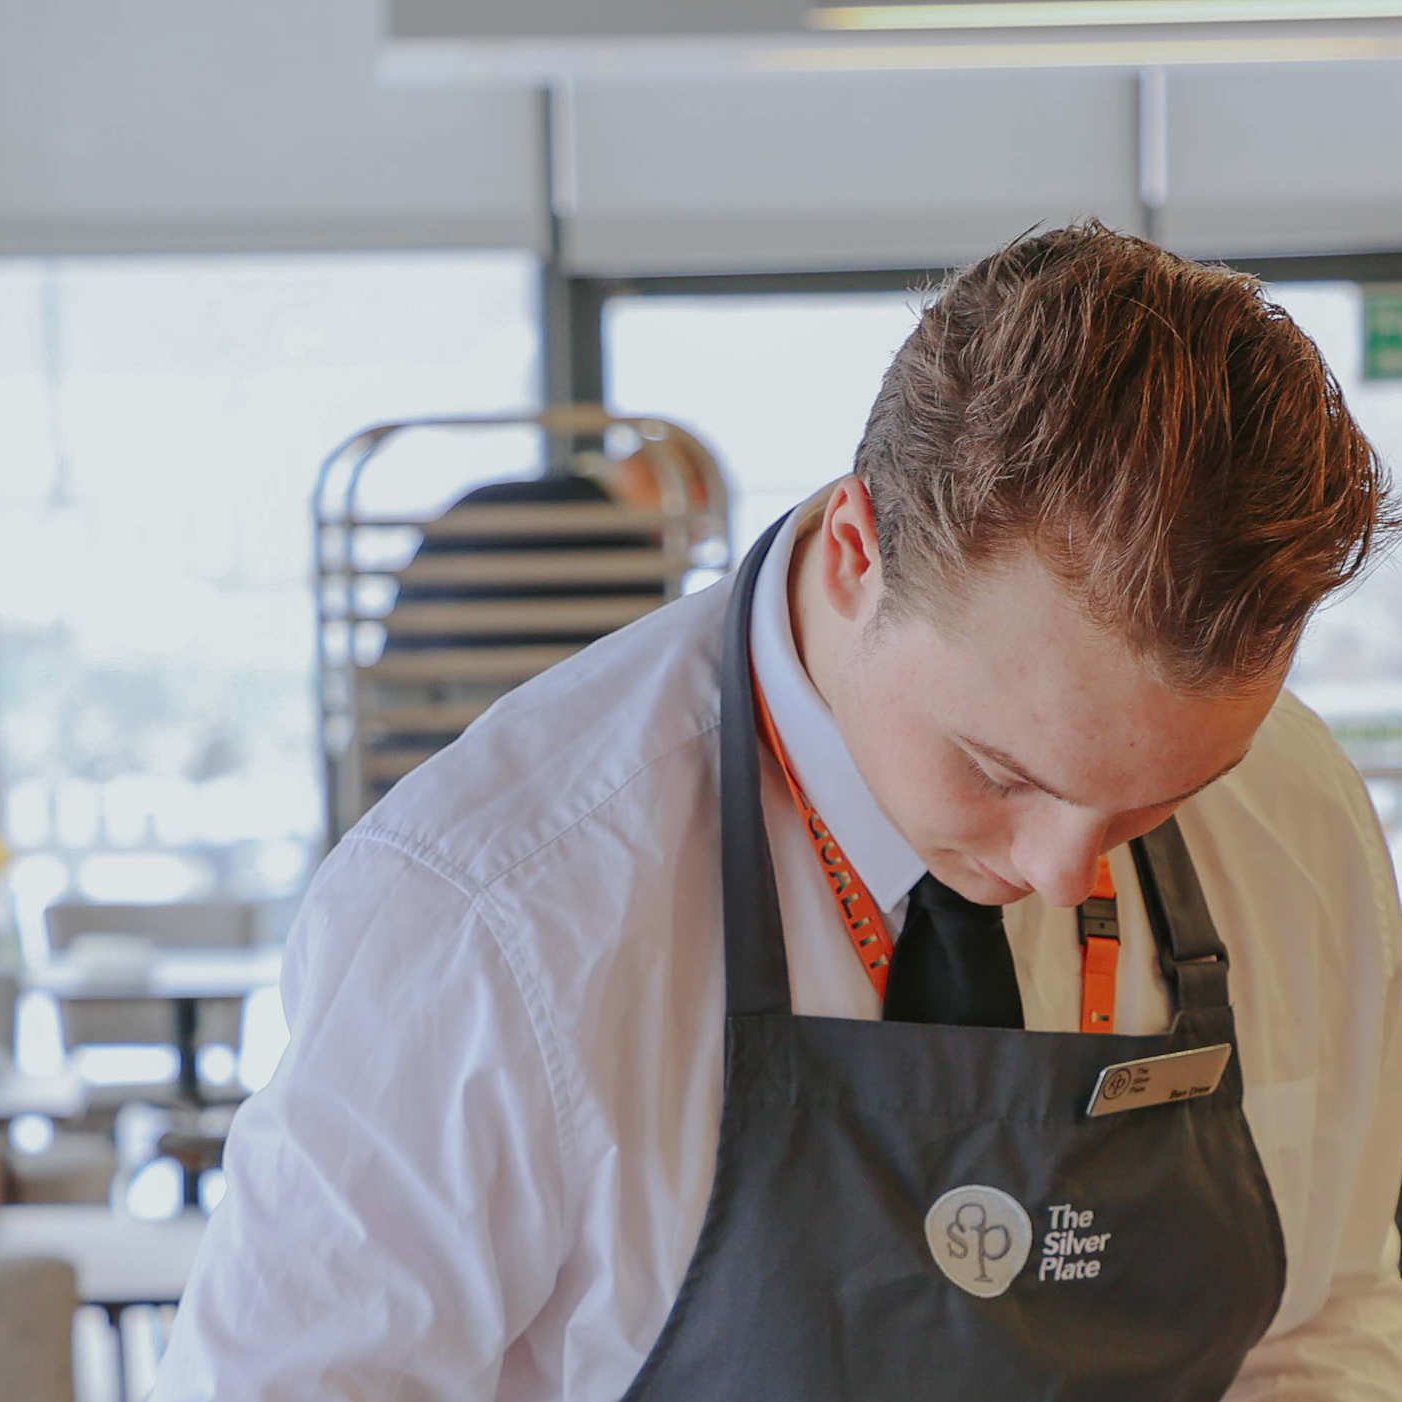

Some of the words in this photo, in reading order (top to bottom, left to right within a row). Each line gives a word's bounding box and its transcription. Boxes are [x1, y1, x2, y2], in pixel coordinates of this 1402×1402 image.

[1048, 1203, 1094, 1230] The
[1042, 1230, 1112, 1257] Silver
[1038, 1256, 1101, 1282] Plate
